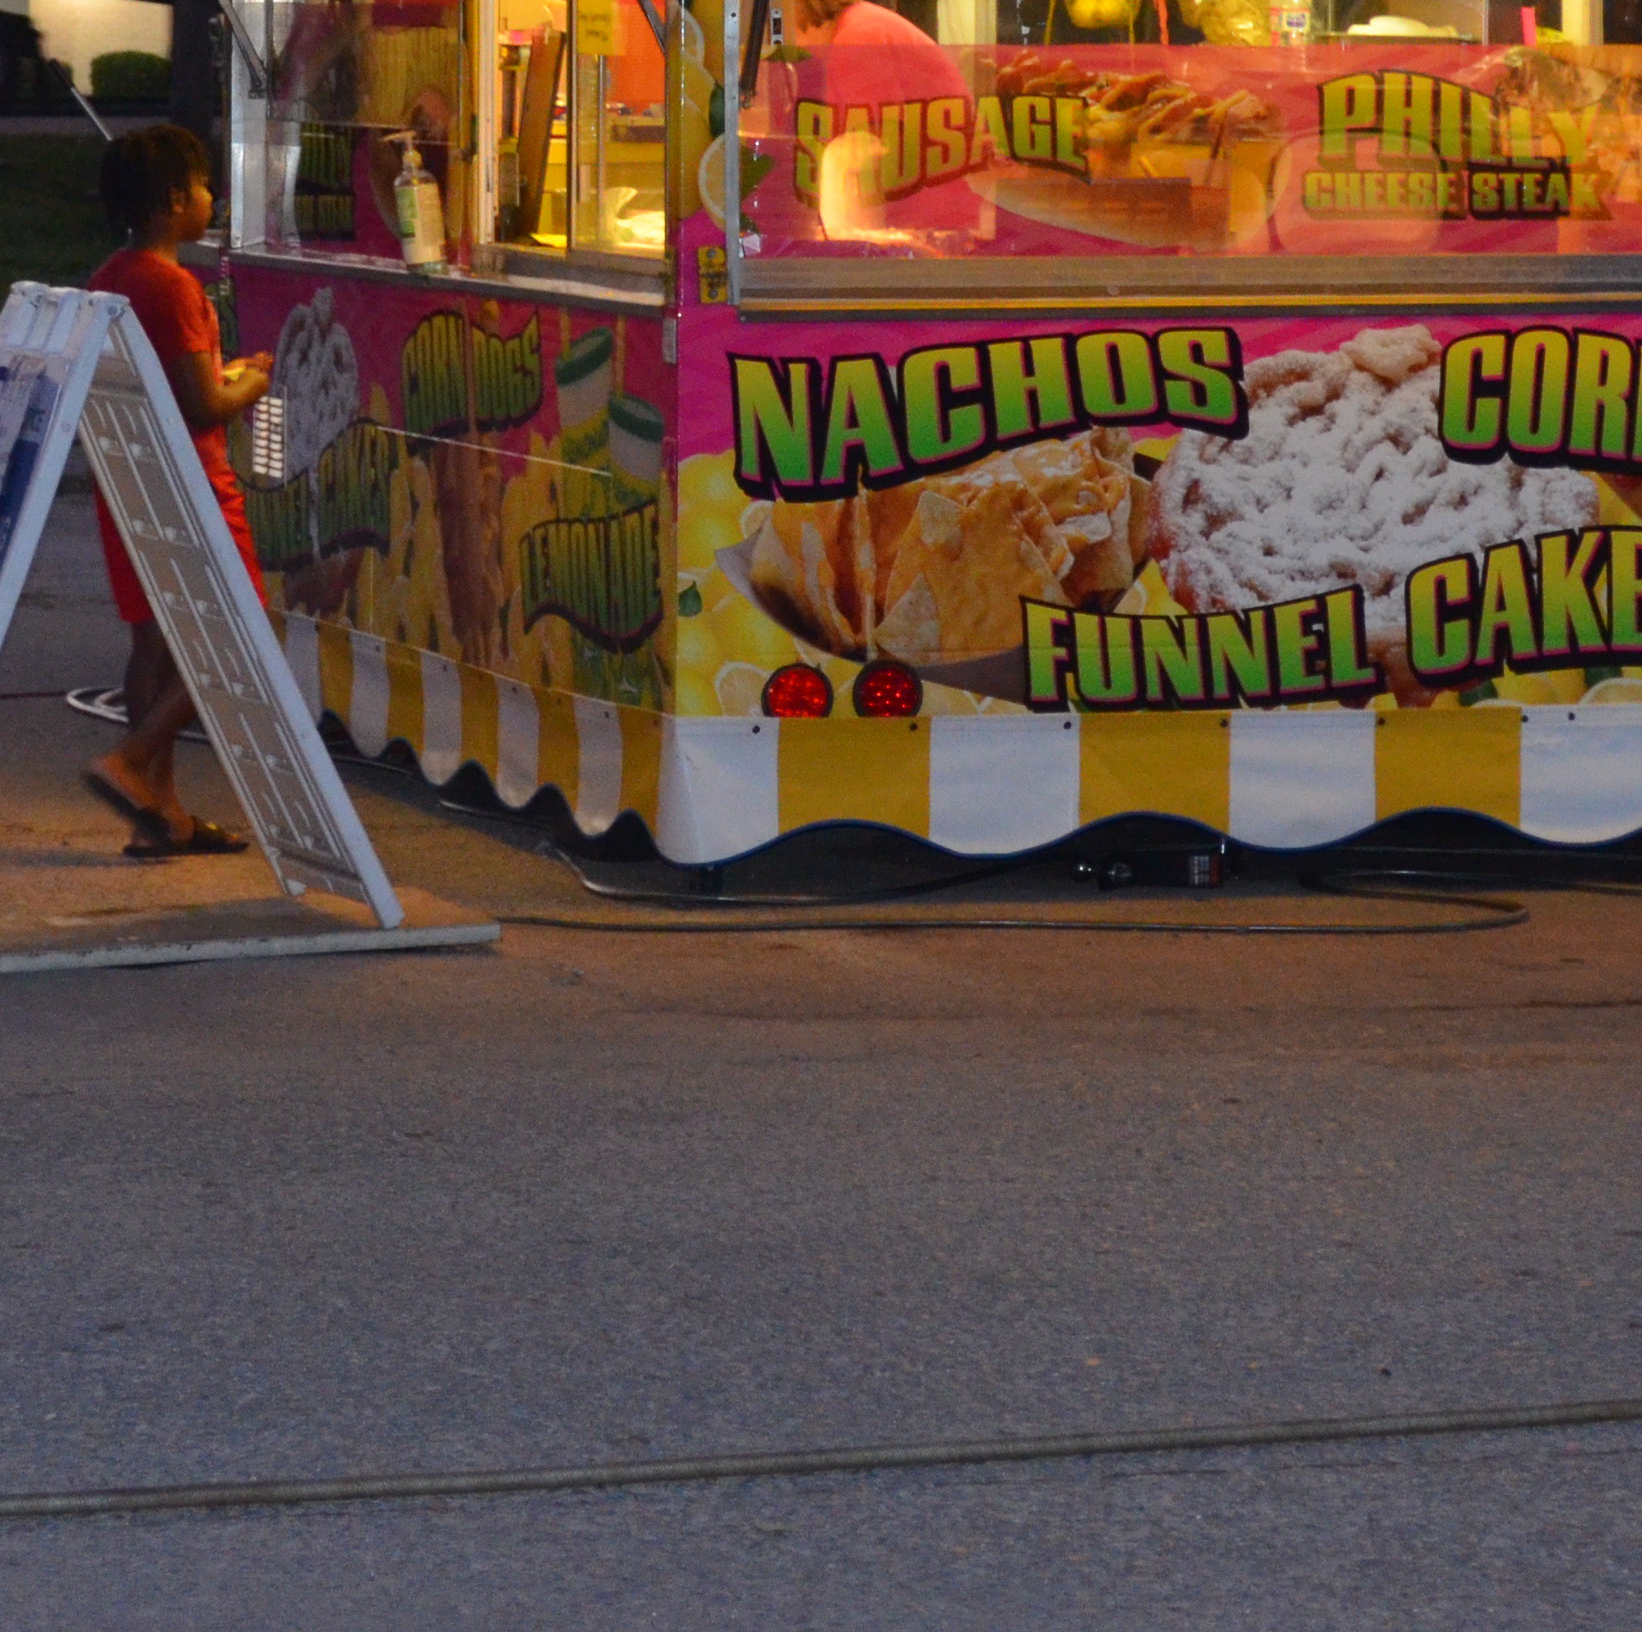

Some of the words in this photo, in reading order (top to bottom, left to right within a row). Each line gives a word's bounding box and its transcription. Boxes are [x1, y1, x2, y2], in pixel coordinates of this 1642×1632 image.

[793, 93, 1093, 208] SAUSAGE
[1317, 70, 1603, 169] PHILLY
[1302, 168, 1466, 220] CHEESE
[1467, 162, 1615, 220] STEAK
[726, 326, 1250, 502] NACHOS
[1018, 583, 1386, 711] FUNNEL
